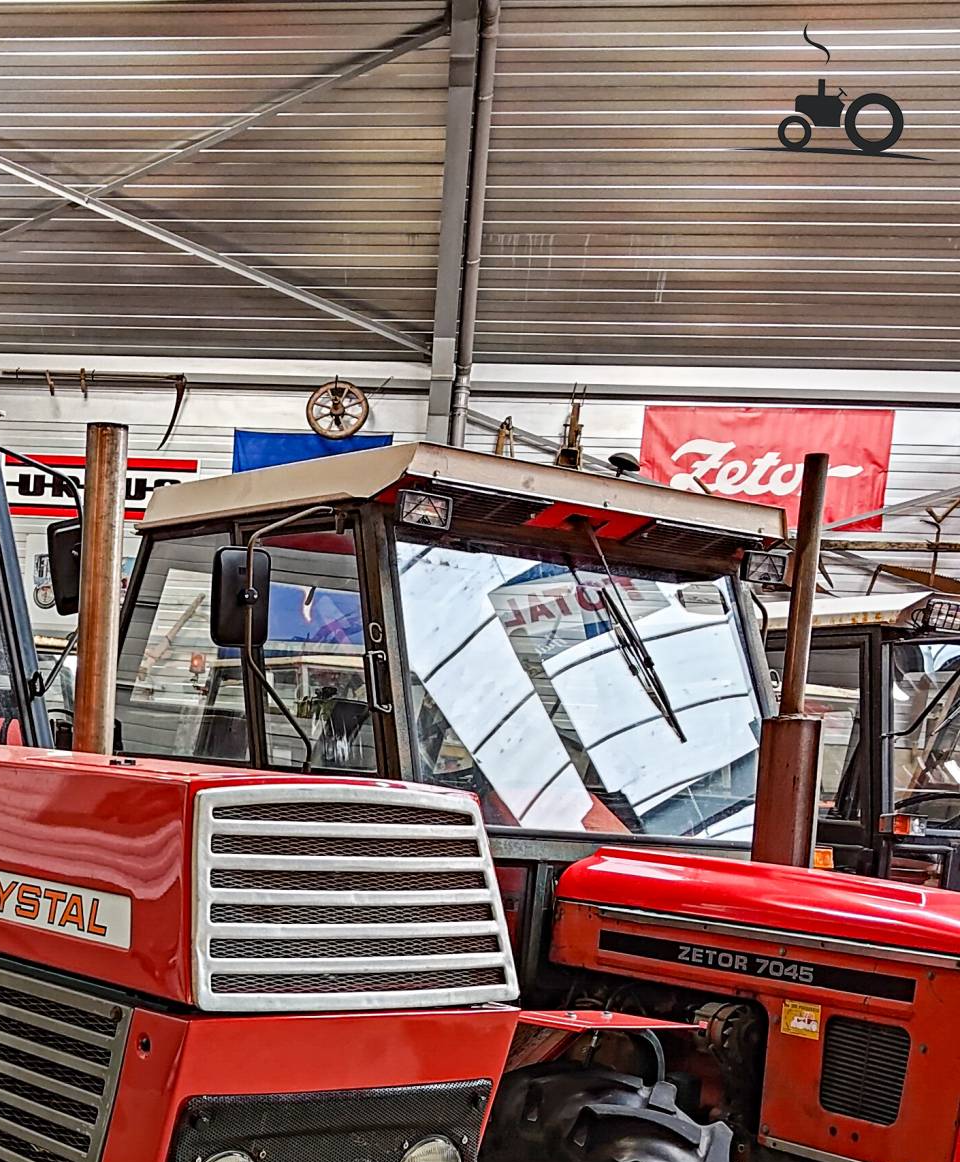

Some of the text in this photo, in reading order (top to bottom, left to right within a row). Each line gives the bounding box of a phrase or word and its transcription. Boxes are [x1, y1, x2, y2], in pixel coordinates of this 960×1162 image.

[17, 473, 182, 501] URU
[677, 945, 814, 983] ZETOR 7045
